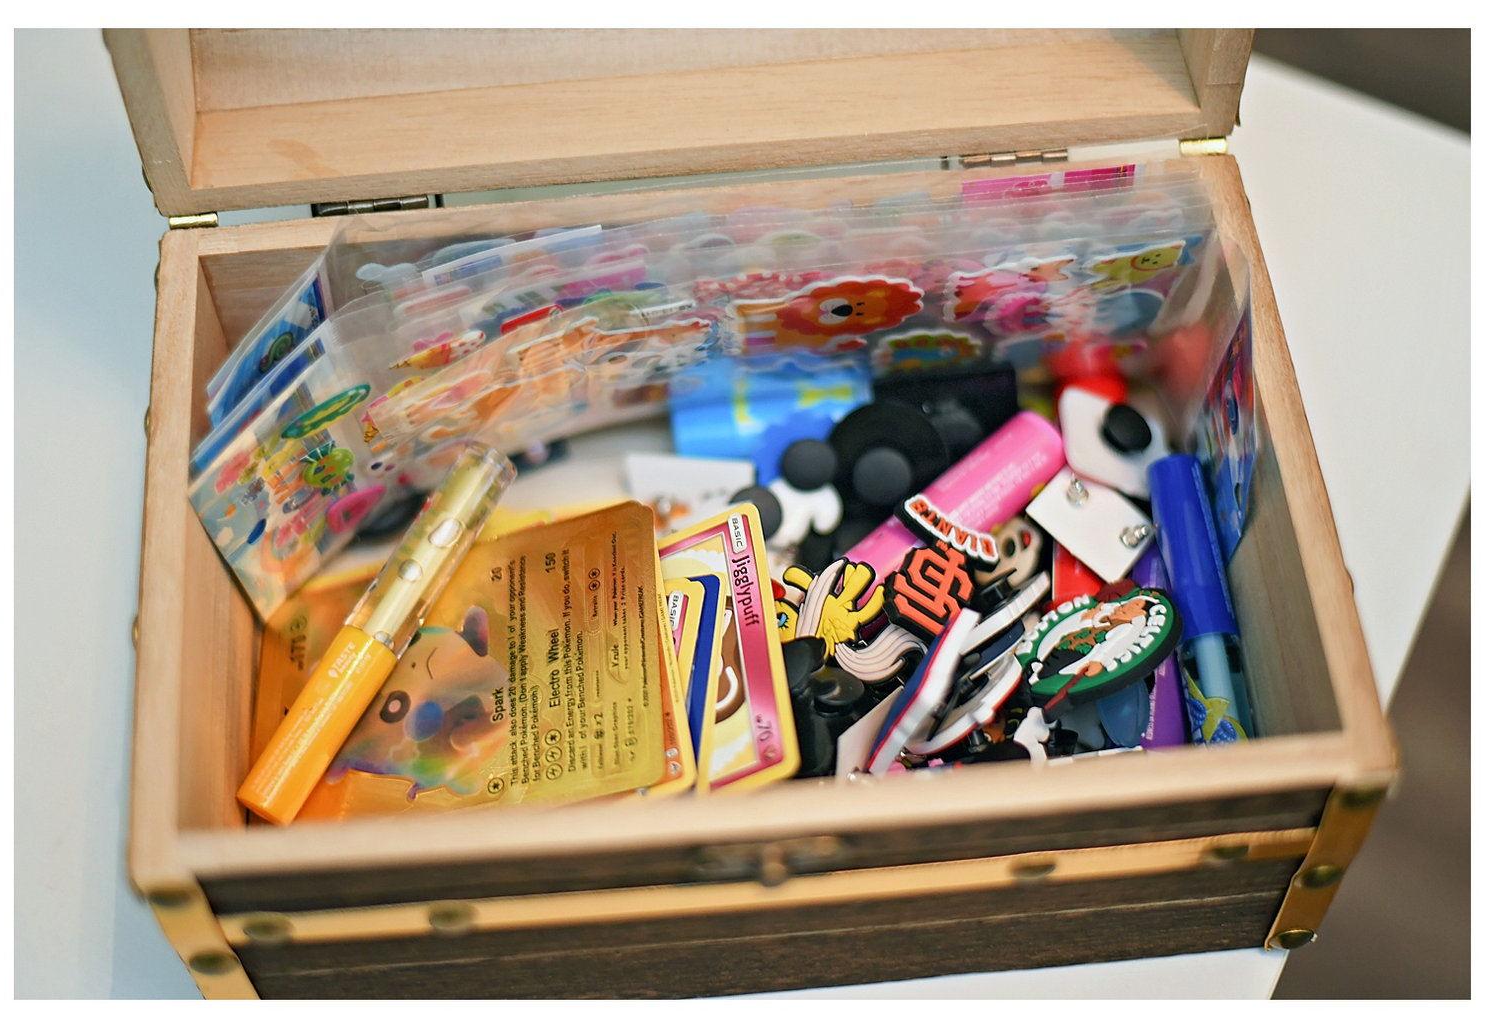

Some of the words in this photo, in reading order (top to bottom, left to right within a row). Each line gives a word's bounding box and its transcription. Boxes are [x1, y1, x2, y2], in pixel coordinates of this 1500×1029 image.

[731, 517, 743, 548] BASIC
[907, 498, 997, 559] GIANTS
[491, 567, 502, 582] 20
[545, 552, 556, 574] 150
[562, 556, 570, 581] switch
[508, 559, 516, 602] opponent's
[518, 555, 526, 597] Resistance
[563, 581, 571, 594] do,
[731, 554, 760, 627] Jigglypuff
[509, 604, 517, 621] your
[518, 596, 526, 612] and
[563, 595, 572, 610] you
[508, 625, 515, 633] of
[518, 612, 526, 653] Weakness
[1015, 593, 1091, 655] BOSTON
[508, 641, 515, 649] to
[547, 628, 560, 663] Wheel
[1103, 603, 1168, 673] CELTICS
[508, 651, 517, 683] damage
[519, 654, 528, 676] apply
[564, 659, 572, 675] this
[508, 686, 516, 696] 20
[549, 668, 561, 708] Electro
[565, 676, 573, 697] from
[577, 672, 585, 709] Benched
[492, 686, 505, 722] Spark
[566, 697, 575, 727] Energy
[509, 719, 517, 737] also
[519, 704, 527, 746] Pokémon.
[579, 709, 588, 728] your
[568, 727, 574, 739] an
[579, 730, 587, 740] of
[756, 720, 773, 742] 70
[509, 741, 517, 766] attack
[532, 731, 540, 768] Benched
[567, 740, 576, 772] Discard
[580, 749, 588, 769] with
[510, 768, 518, 786] This
[520, 747, 529, 784] Benched
[532, 769, 540, 782] for
